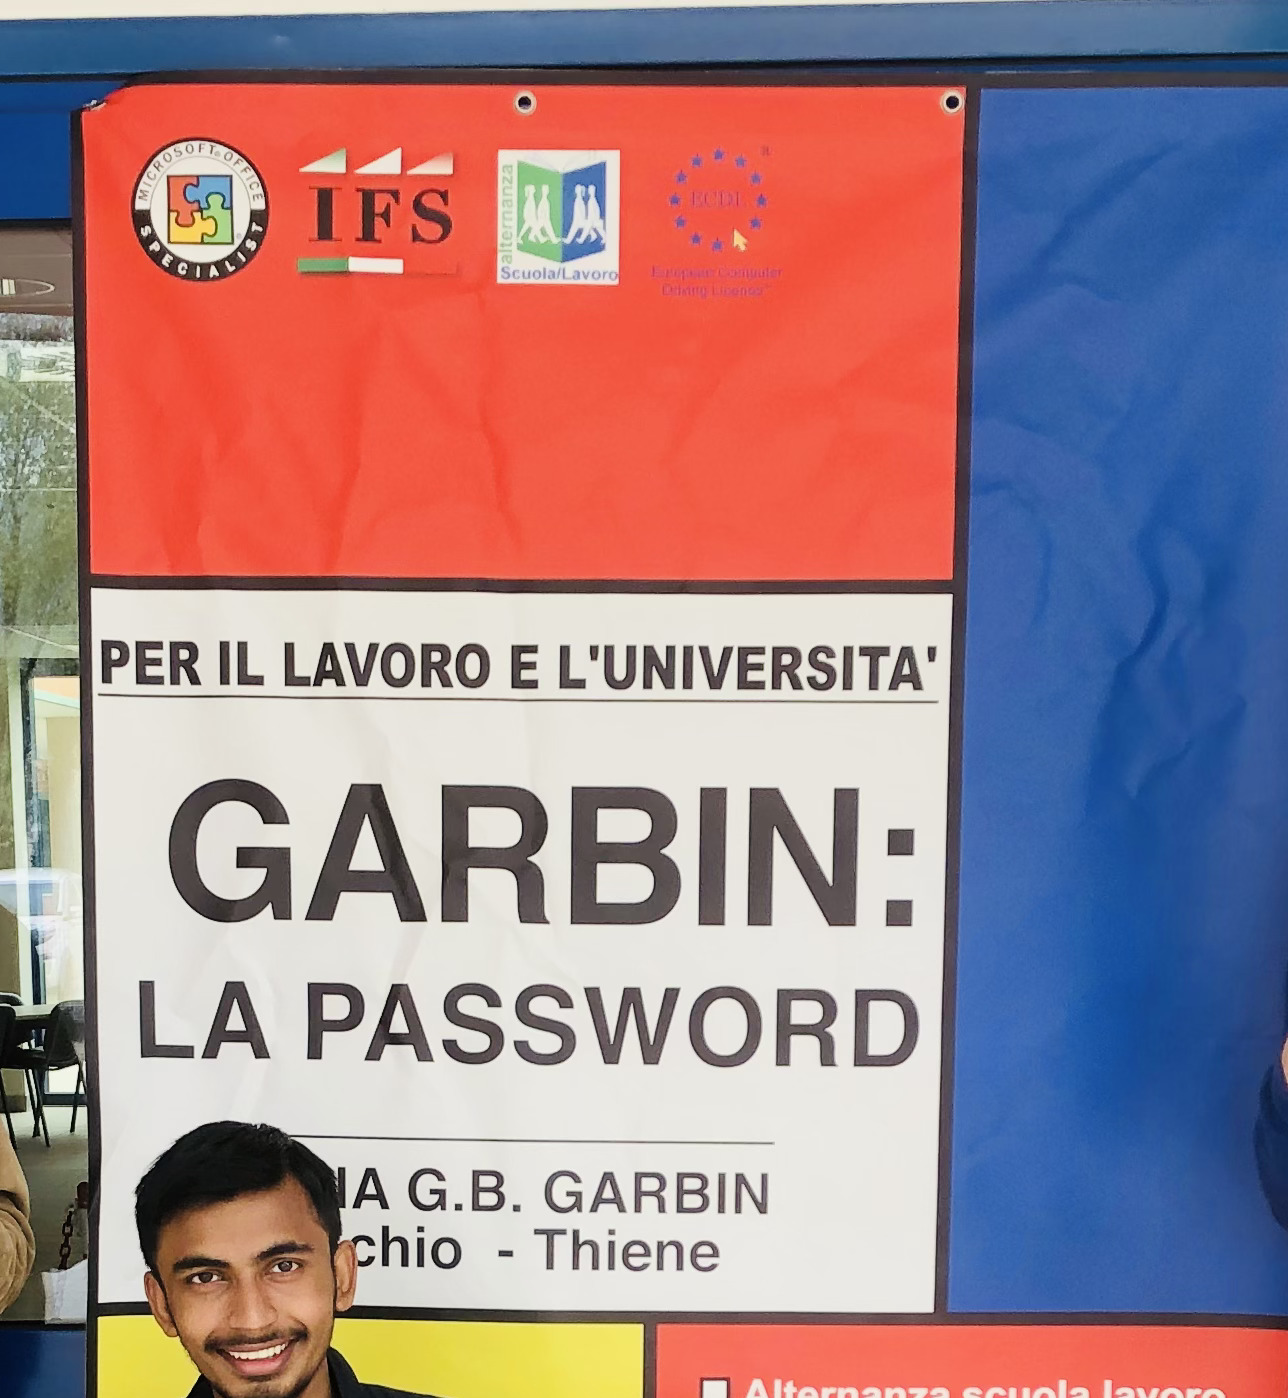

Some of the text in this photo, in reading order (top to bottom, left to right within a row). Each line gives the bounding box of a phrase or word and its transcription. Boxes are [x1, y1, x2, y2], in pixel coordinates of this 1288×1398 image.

[224, 151, 264, 202] OFFICE
[690, 190, 746, 208] ECDL
[308, 186, 453, 243] IFS
[501, 163, 514, 265] alternanza
[140, 222, 264, 278] SPECIALIST
[500, 265, 618, 281] Scuola/Lavoro
[718, 264, 782, 282] Computer
[100, 639, 937, 692] PER IL LAVORO E L'UNIVERSITA'
[168, 778, 915, 927] GARBIN:
[138, 980, 920, 1068] LA PASSWORD
[338, 1166, 769, 1215] IA G.B. GARBIN
[352, 1225, 720, 1273] chio - Thiene
